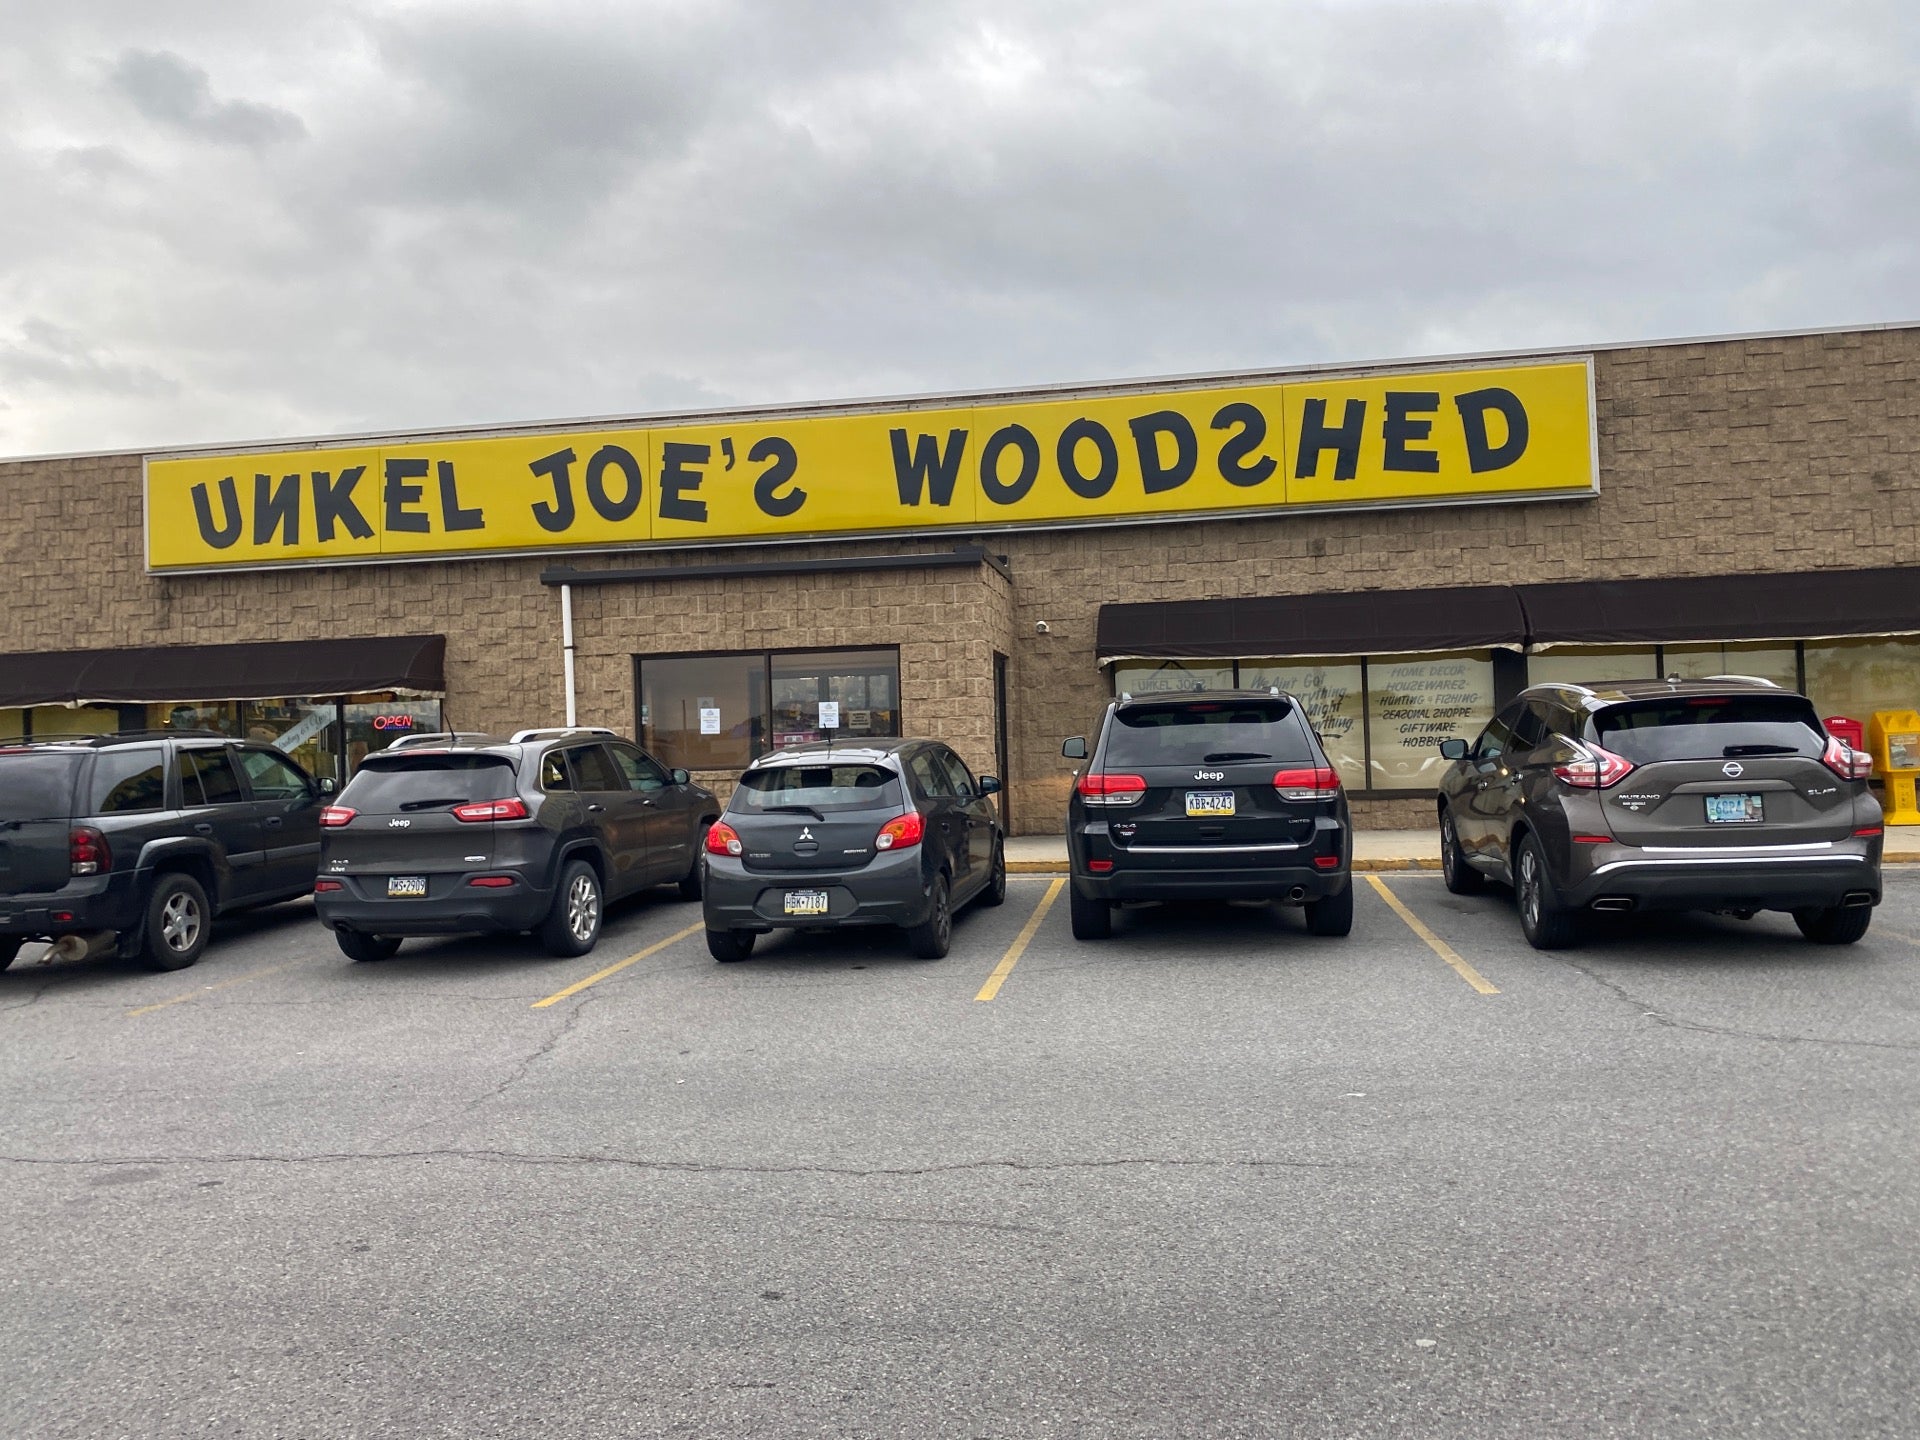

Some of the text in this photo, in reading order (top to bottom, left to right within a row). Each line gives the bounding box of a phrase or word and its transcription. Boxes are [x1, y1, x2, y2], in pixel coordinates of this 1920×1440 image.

[190, 387, 1530, 549] UNKEL JOE'S WOODSHED
[1390, 665, 1465, 677] HOME DECOR
[1303, 671, 1328, 688] Got
[1386, 680, 1467, 691] HOUSEWARES
[1380, 694, 1425, 706] HUNTING
[1435, 692, 1479, 705] FISHING
[1307, 699, 1342, 718] Might
[1382, 707, 1472, 720] SEASONAL SHOPPE
[373, 715, 413, 730] OPEN
[1399, 722, 1457, 734] GIFTWARE
[1193, 770, 1225, 781] Jeep
[388, 818, 410, 828] Jeep
